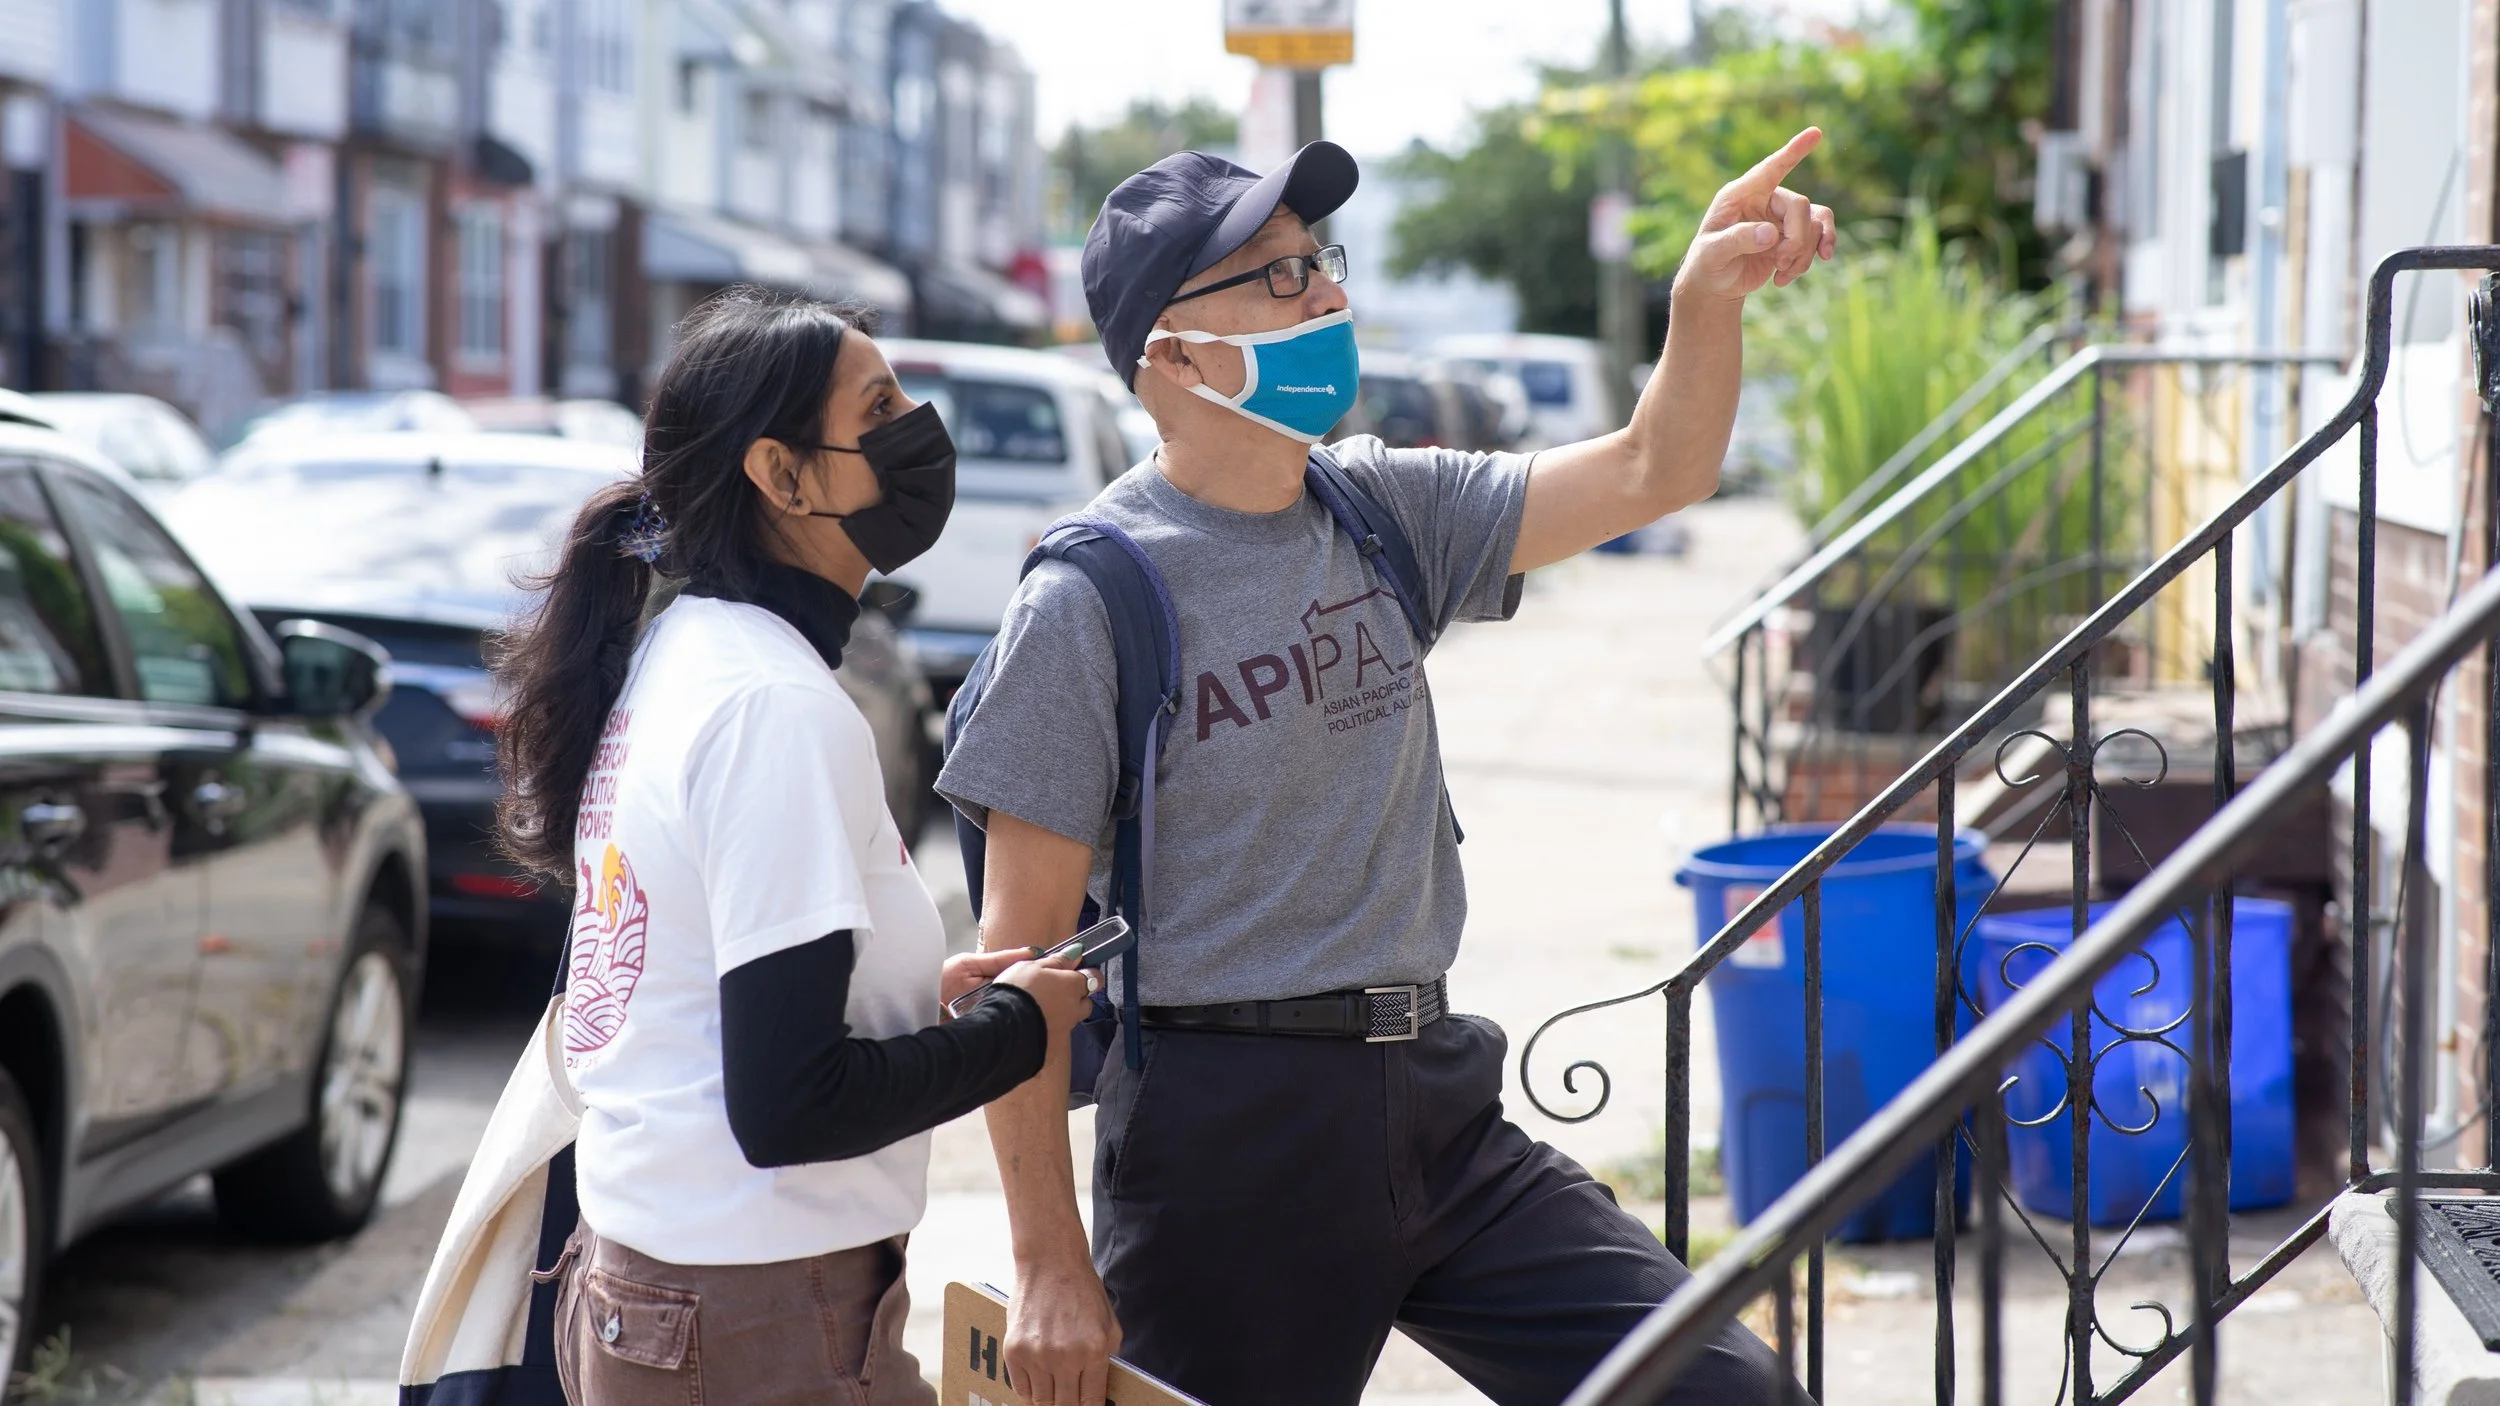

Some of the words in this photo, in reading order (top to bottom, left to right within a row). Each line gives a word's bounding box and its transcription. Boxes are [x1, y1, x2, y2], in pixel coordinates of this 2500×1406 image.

[1277, 385, 1326, 394] Independence
[1323, 695, 1361, 718] ASIAN
[1362, 677, 1410, 705] PACIFIC
[601, 709, 634, 738] SIAN
[1328, 706, 1392, 735] POLITICAL
[578, 811, 613, 840] POWER
